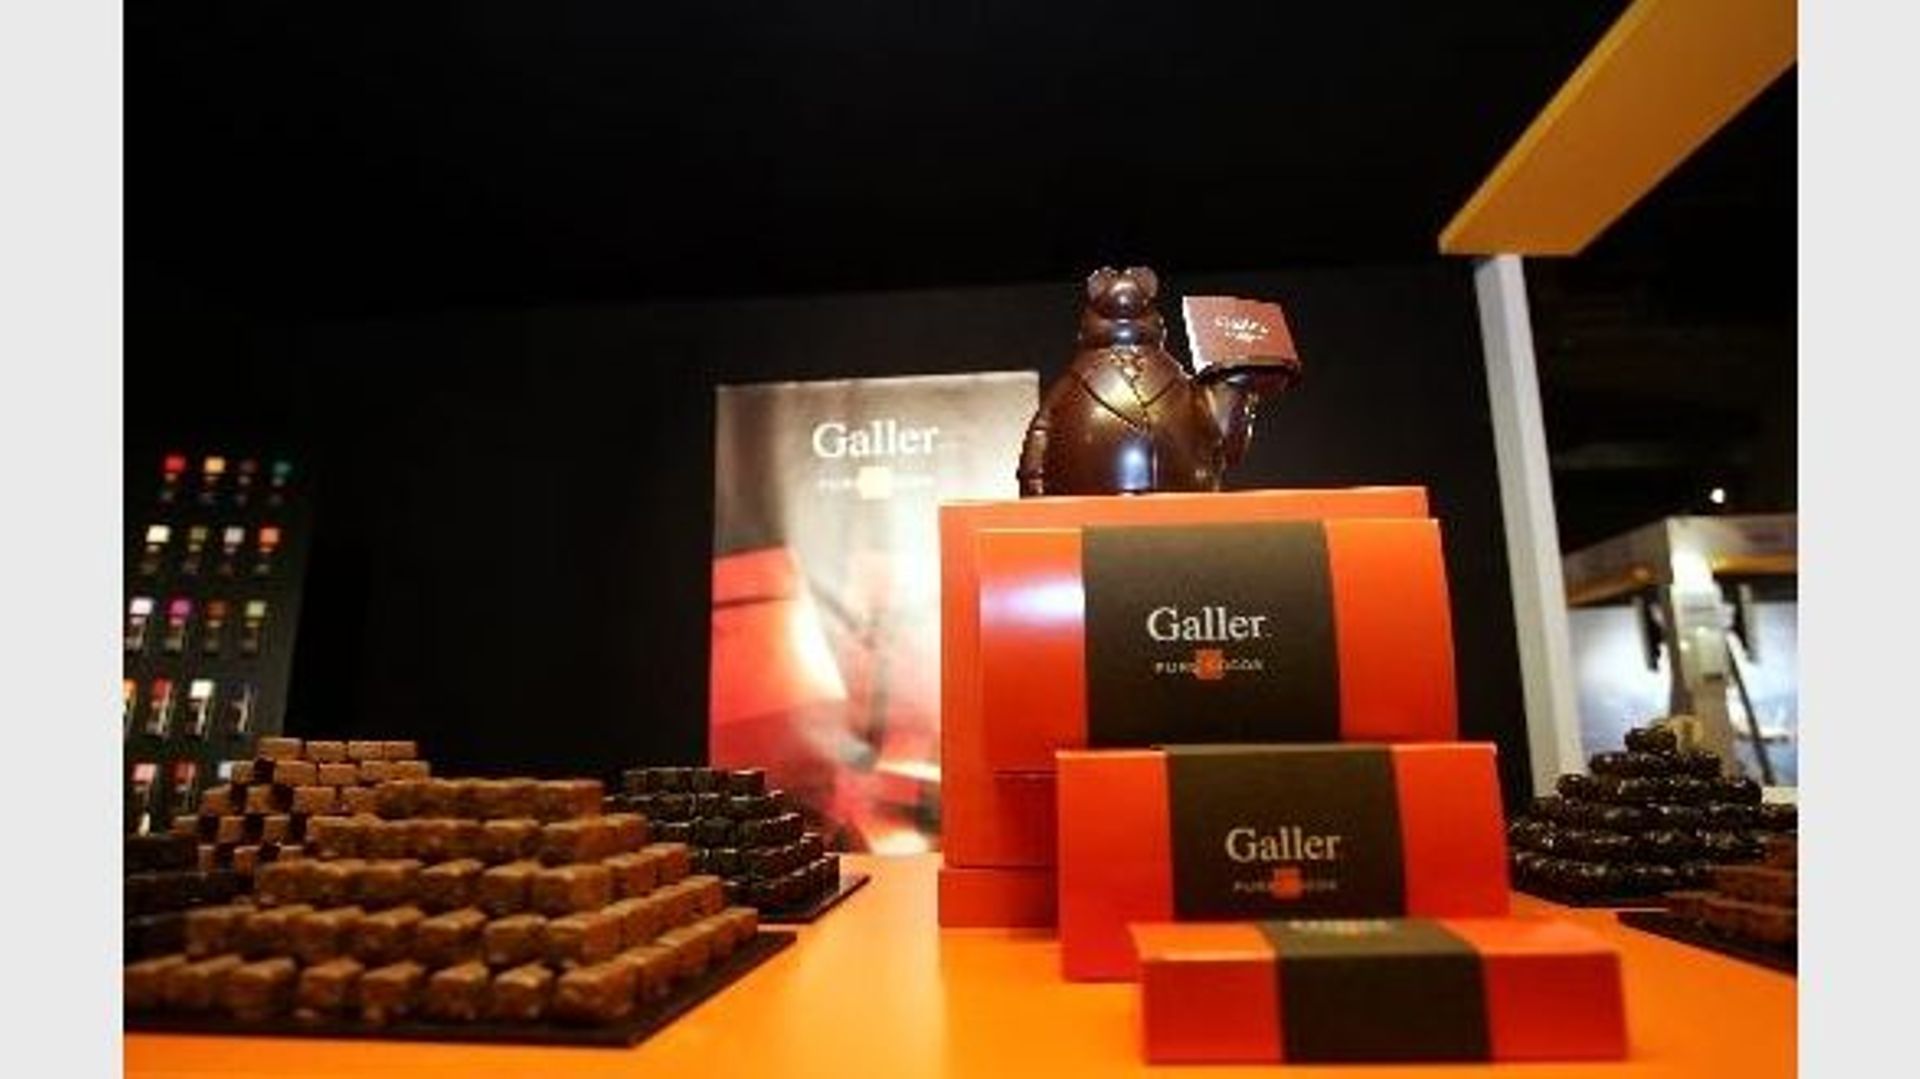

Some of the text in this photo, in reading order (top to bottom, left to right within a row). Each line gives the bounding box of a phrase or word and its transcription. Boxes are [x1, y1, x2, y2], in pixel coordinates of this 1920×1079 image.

[812, 420, 939, 459] Galler
[1146, 605, 1266, 641] Galler
[1225, 826, 1341, 863] Galler
